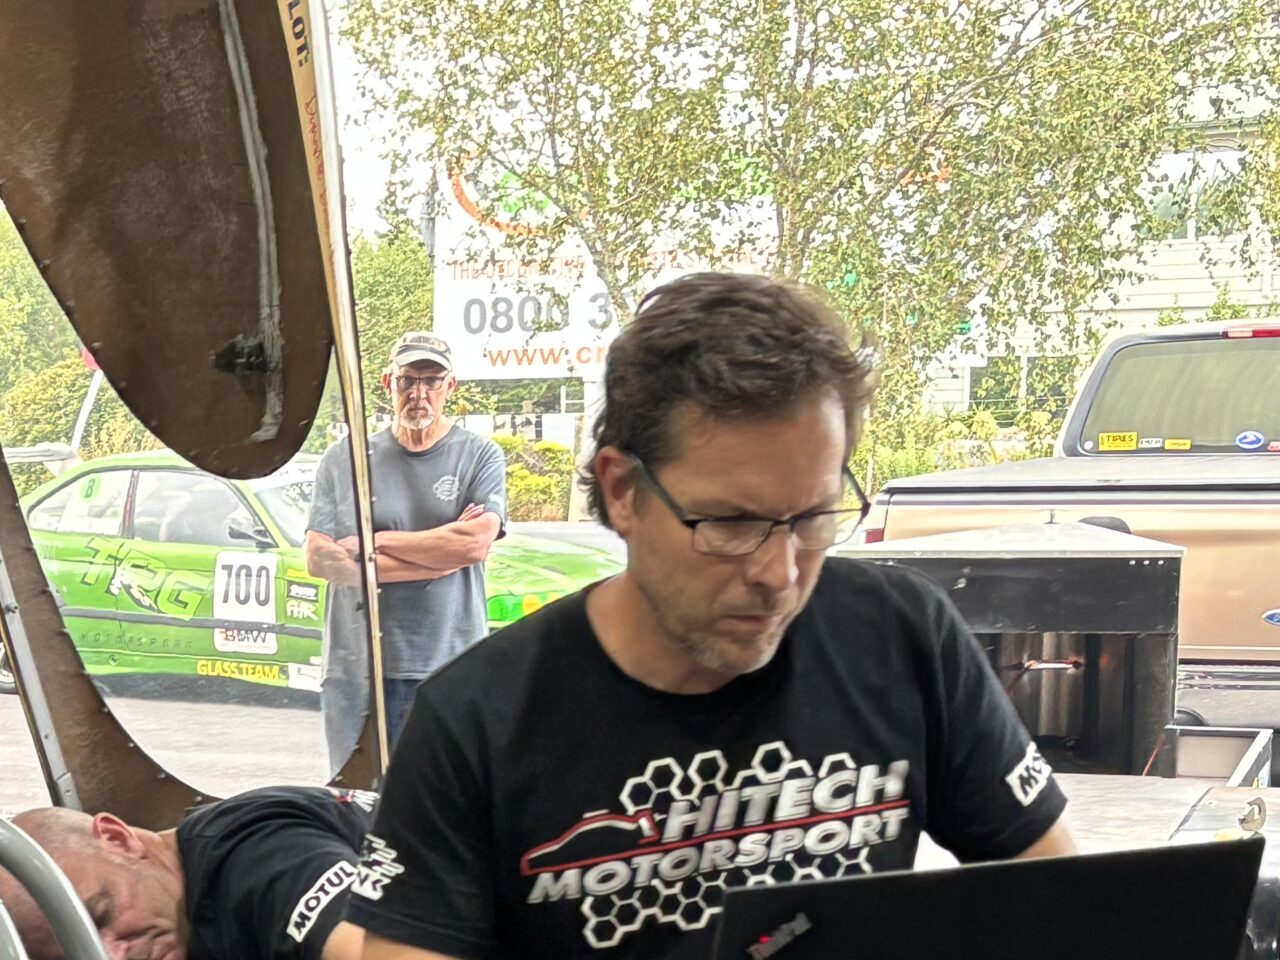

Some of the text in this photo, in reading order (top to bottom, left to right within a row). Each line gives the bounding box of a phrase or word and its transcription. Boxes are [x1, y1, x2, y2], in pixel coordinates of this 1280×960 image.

[463, 294, 570, 334] 0800
[221, 564, 270, 606] 700
[661, 759, 910, 843] HITECH
[526, 808, 910, 904] MOTORSPORT
[293, 865, 355, 935] MOTUL
